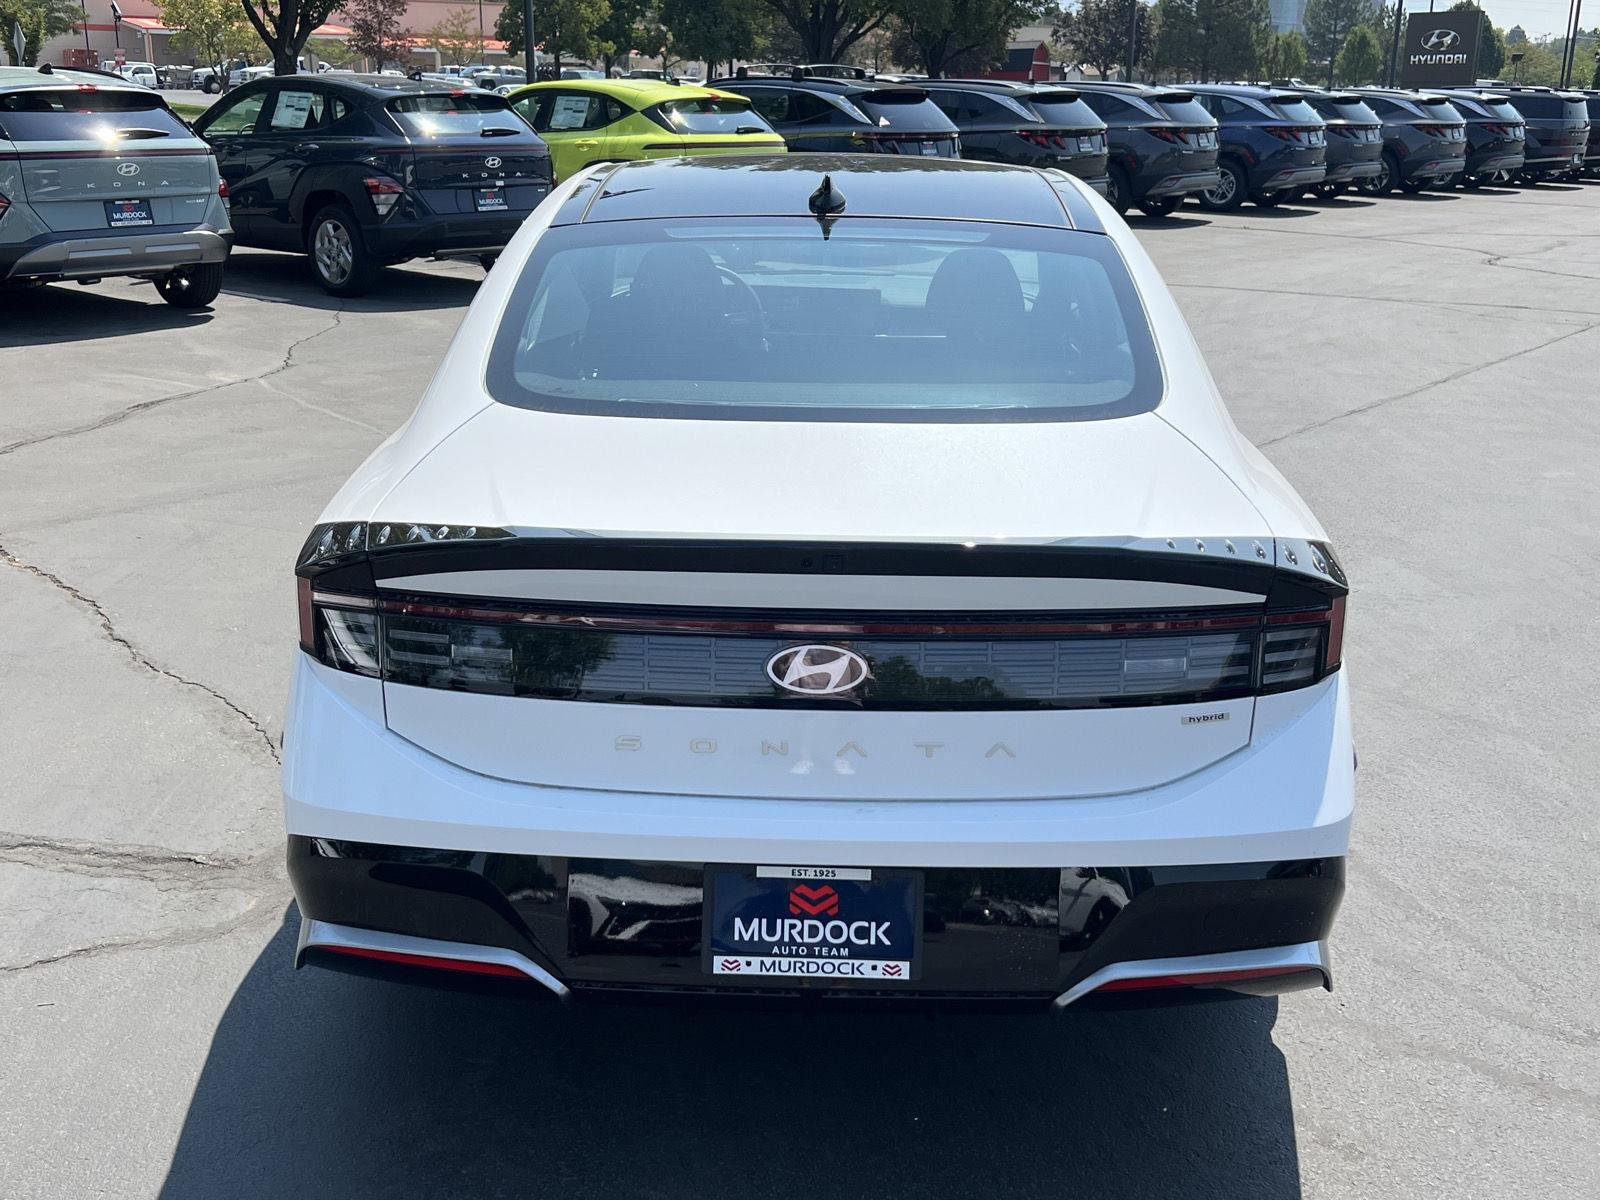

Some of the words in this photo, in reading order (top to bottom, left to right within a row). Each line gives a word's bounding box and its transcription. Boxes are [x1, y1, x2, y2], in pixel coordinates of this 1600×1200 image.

[1410, 54, 1467, 65] HYUNDAI
[86, 180, 169, 188] KONA
[113, 211, 147, 219] MURDOCK
[1188, 713, 1225, 723] hybrid
[614, 734, 1017, 758] SONATA
[791, 868, 810, 877] EST.
[813, 869, 836, 878] 1925
[734, 917, 891, 946] MURDOCK
[772, 945, 808, 956] AUTO
[815, 946, 849, 957] TEAM
[759, 959, 865, 975] MURDOCK
